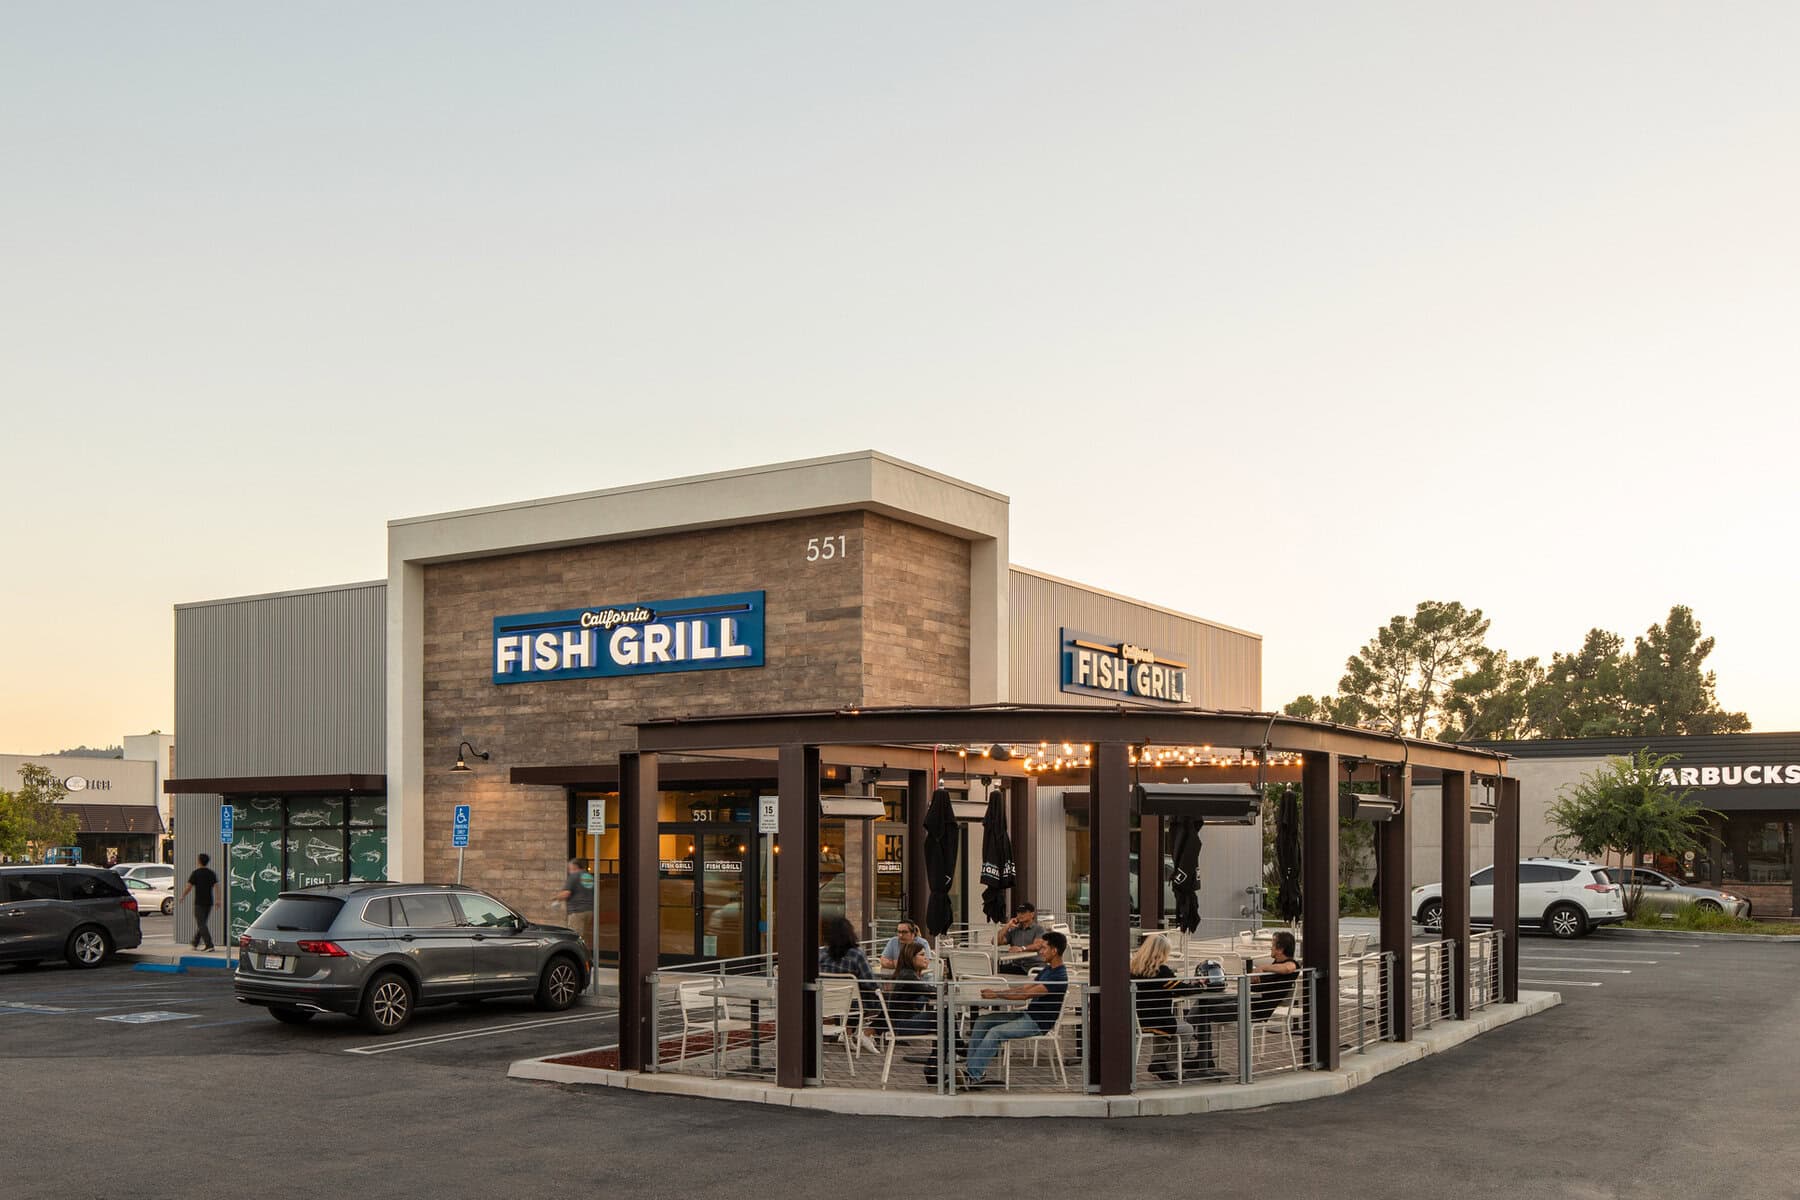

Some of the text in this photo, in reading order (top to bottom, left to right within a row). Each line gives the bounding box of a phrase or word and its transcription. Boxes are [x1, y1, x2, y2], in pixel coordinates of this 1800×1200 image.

[806, 535, 846, 562] 551
[580, 606, 650, 630] California
[496, 617, 750, 674] FISH GRILL
[1078, 650, 1193, 703] FISH GRILL
[592, 808, 601, 817] 15
[693, 809, 712, 822] 551
[764, 805, 774, 814] 15
[305, 877, 326, 887] FISH
